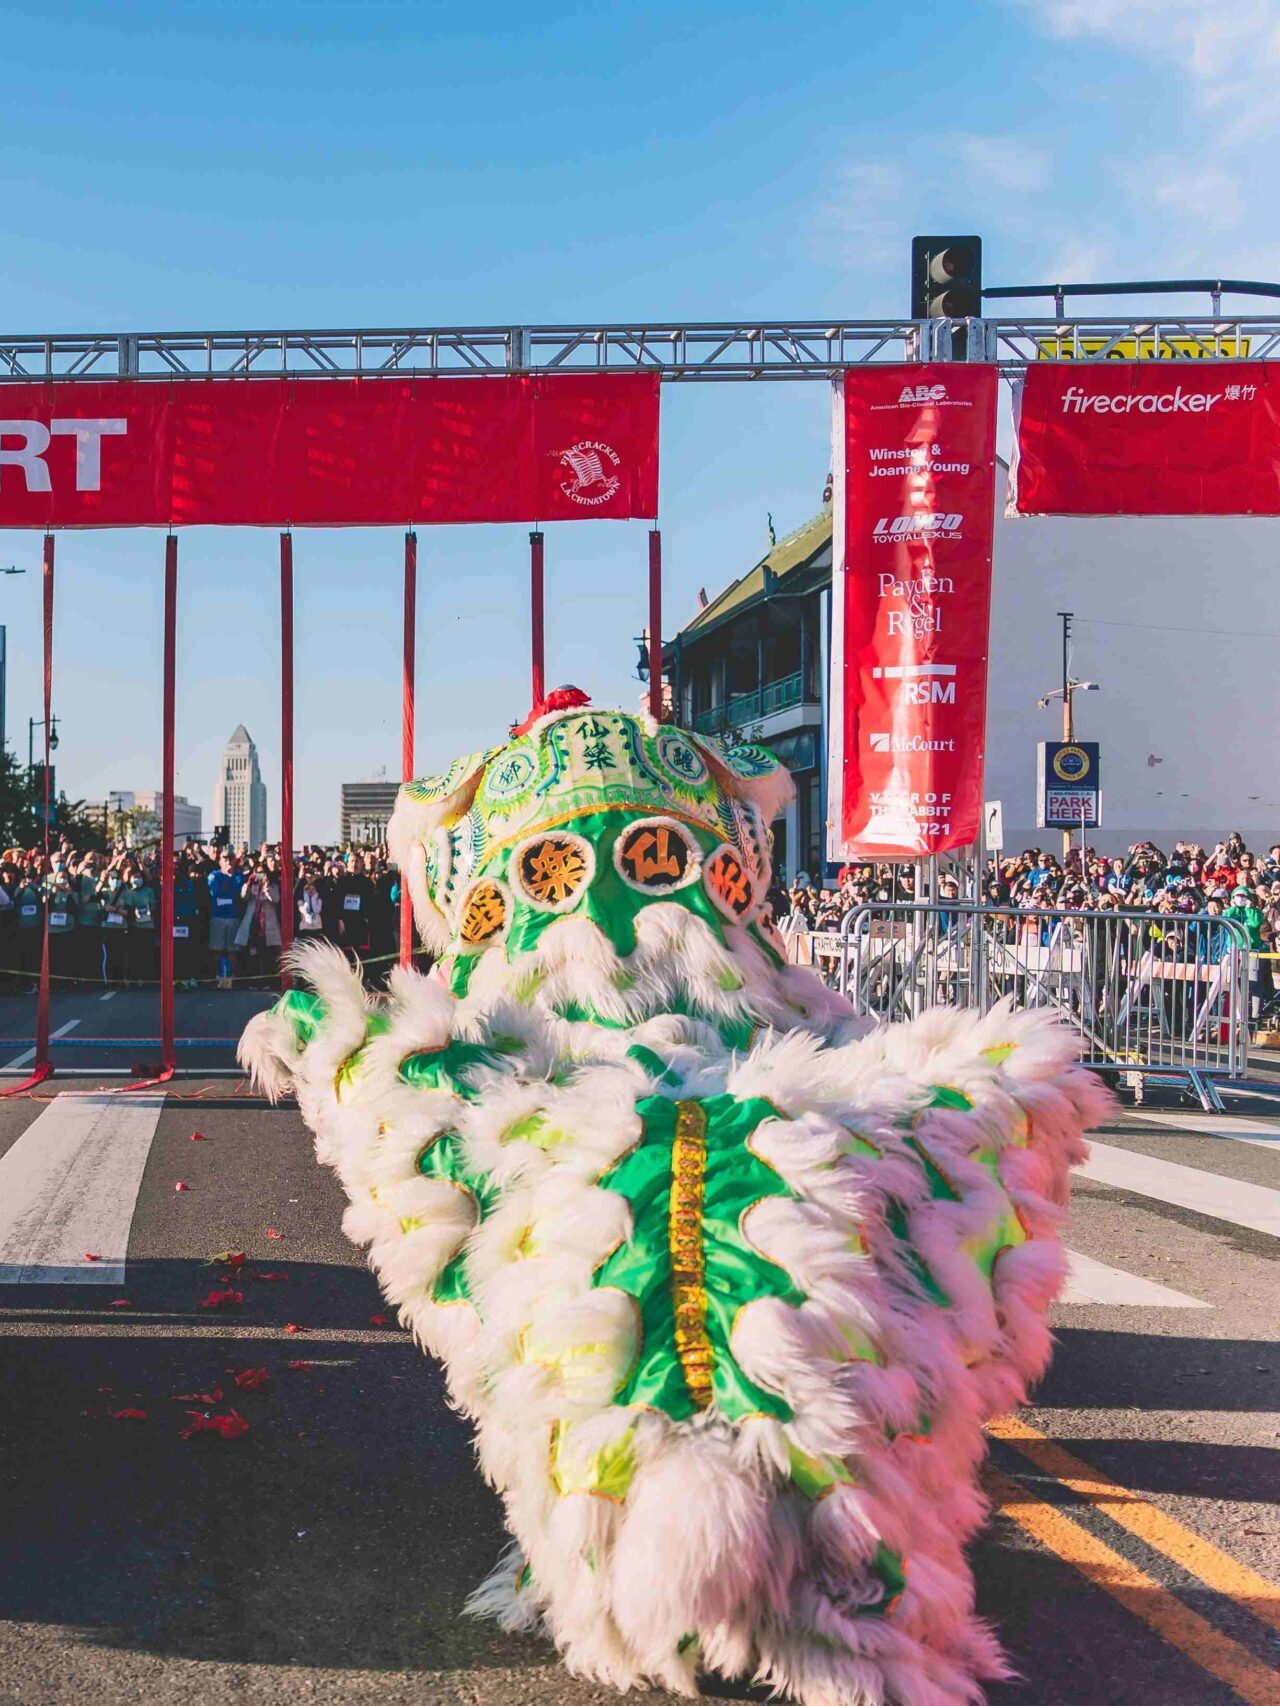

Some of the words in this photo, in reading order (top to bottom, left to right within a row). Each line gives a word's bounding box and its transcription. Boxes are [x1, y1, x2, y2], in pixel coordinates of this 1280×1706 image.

[898, 384, 947, 403] ABC
[1061, 386, 1222, 414] firecracker
[1223, 384, 1258, 401] 爆竹
[931, 444, 941, 456] &
[869, 464, 921, 477] Joanne
[925, 460, 970, 475] Young
[872, 533, 913, 544] TOYOTA
[913, 531, 963, 541] LEXUS
[877, 571, 956, 601] Payden
[910, 594, 929, 618] &
[904, 681, 956, 705] RSM
[891, 735, 955, 752] McCourt
[924, 793, 952, 804] OF
[1049, 796, 1093, 808] PARK
[1049, 808, 1094, 820] HERE
